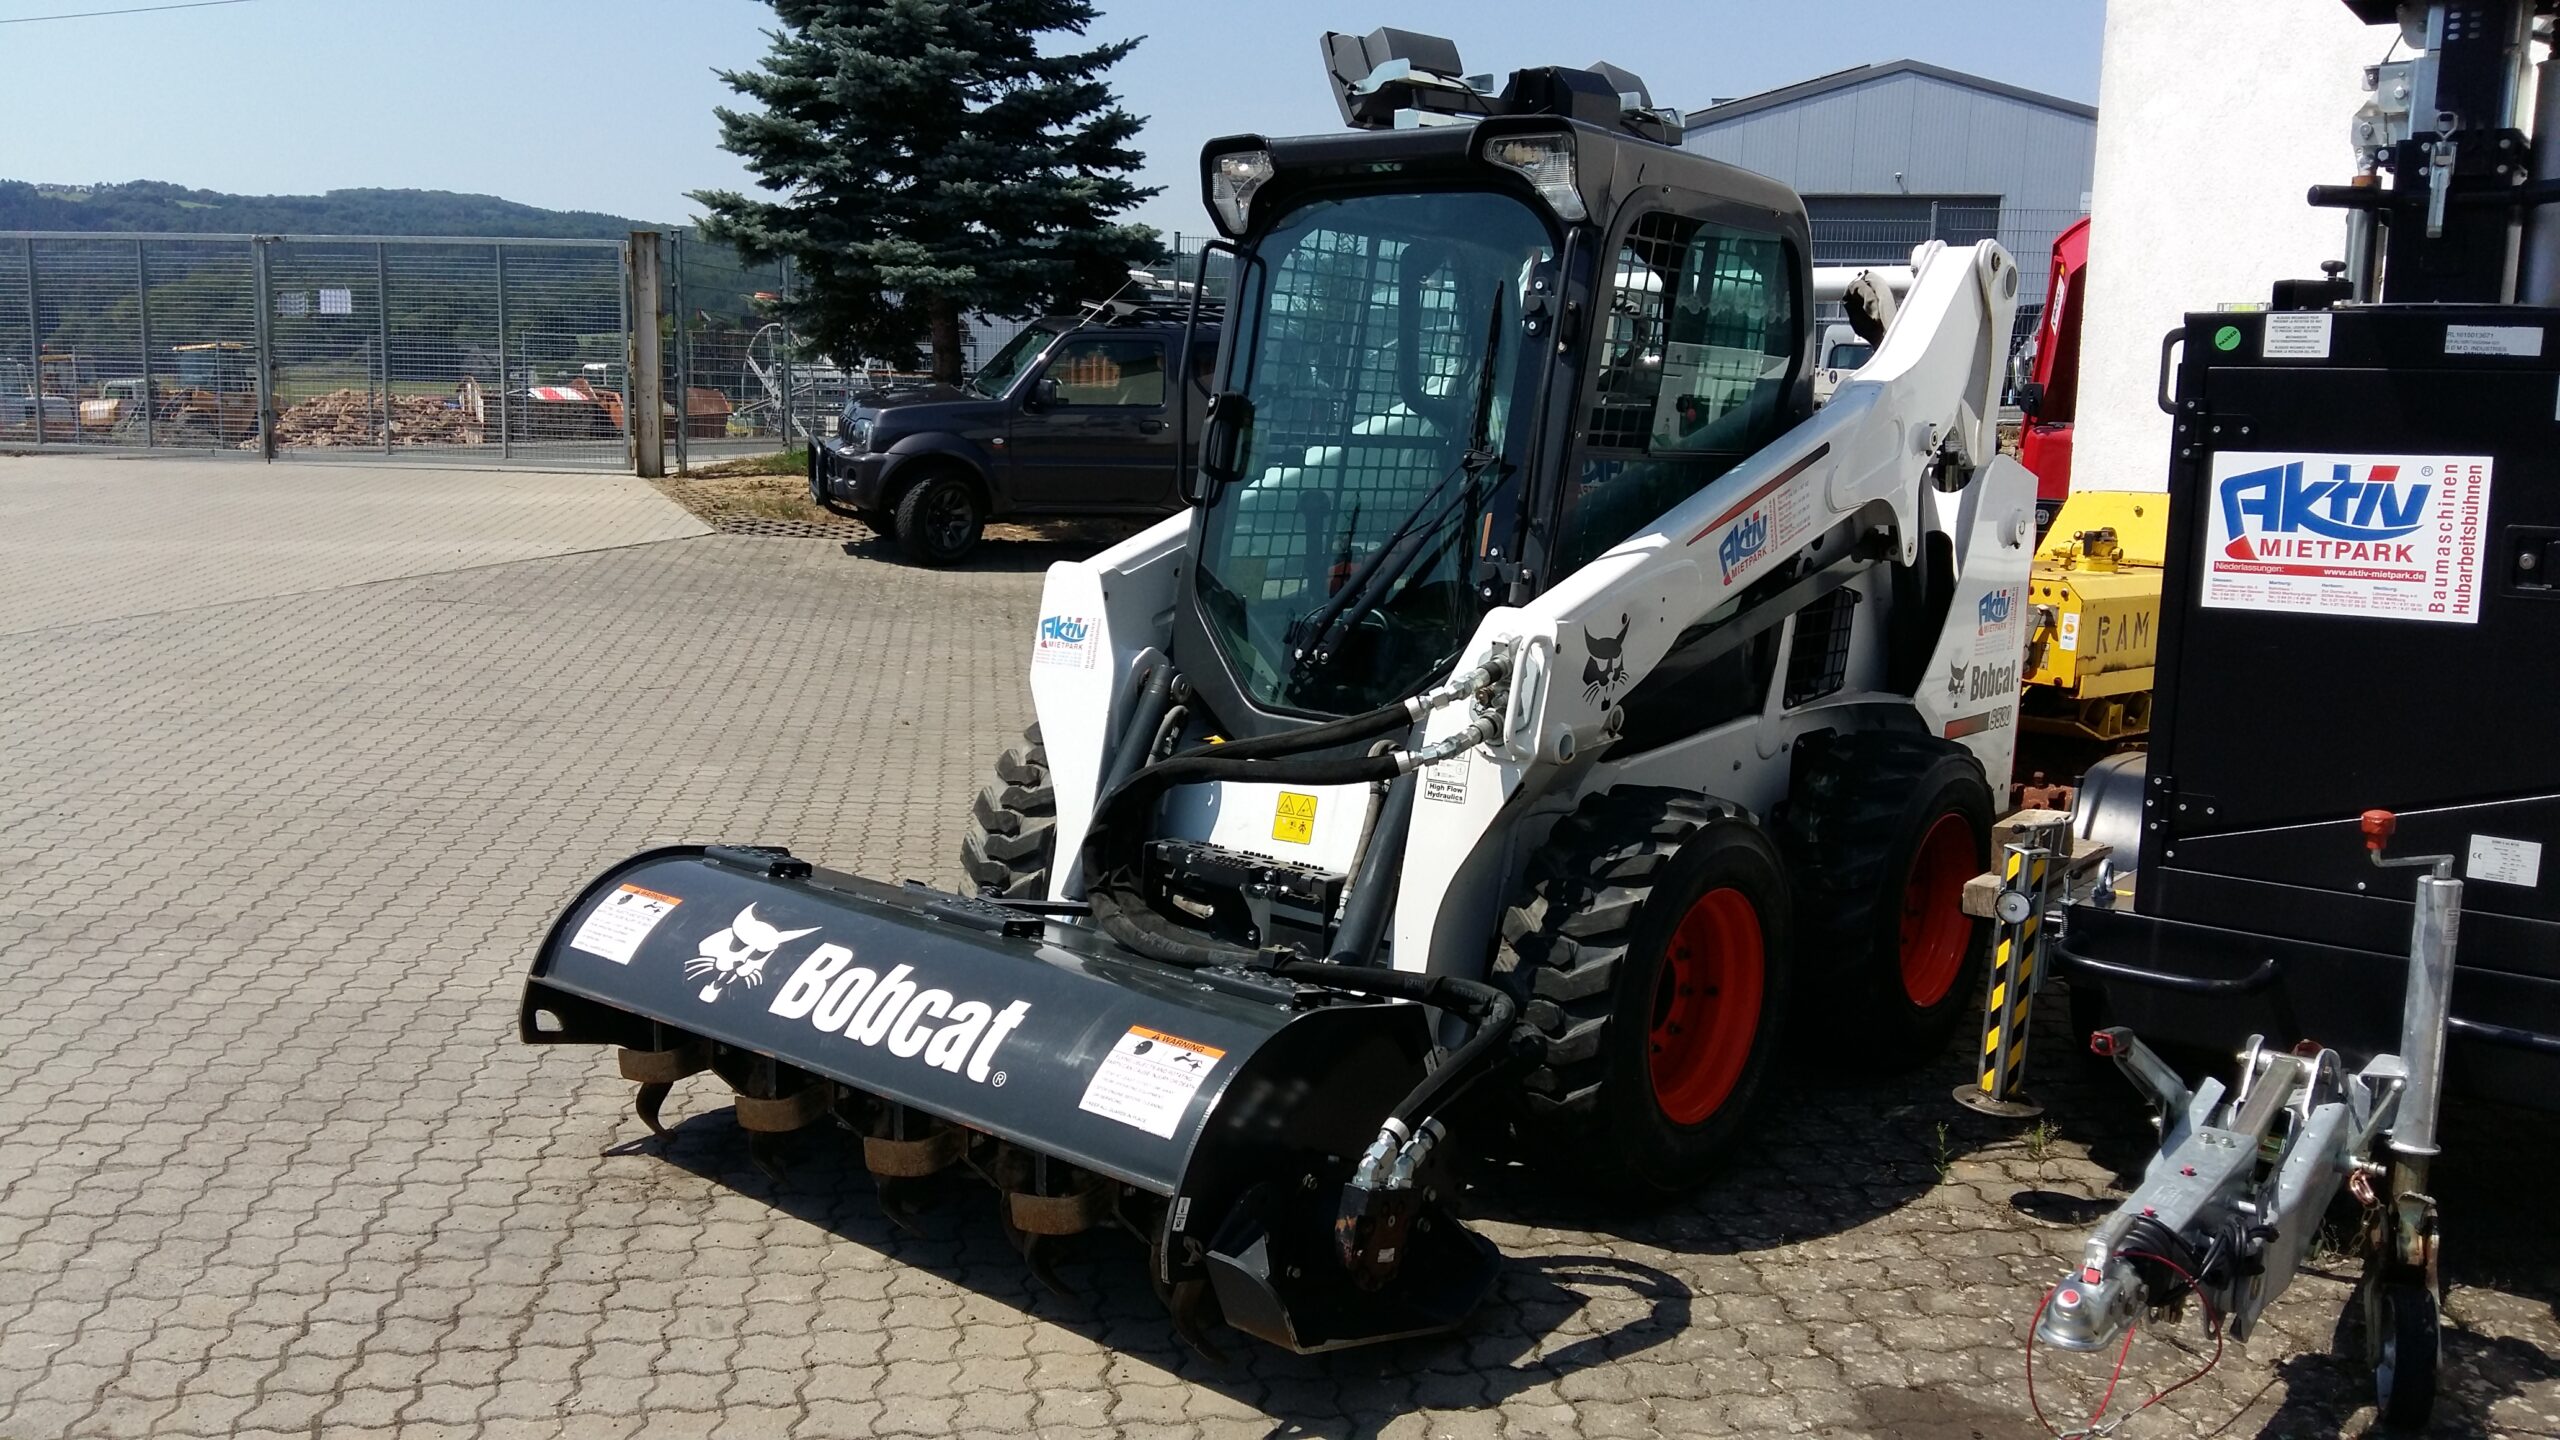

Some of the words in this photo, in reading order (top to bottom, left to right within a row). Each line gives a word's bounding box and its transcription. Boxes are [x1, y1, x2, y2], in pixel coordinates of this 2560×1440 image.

[2428, 463, 2459, 613] Baumaschinen
[2452, 464, 2483, 615] Hubarbeitsbühnen
[2259, 537, 2414, 563] MIETPARK
[1731, 546, 1768, 579] MIETPARK
[2215, 562, 2285, 574] Niederlassungen:
[2323, 569, 2424, 580] www.aktiv-mietpark.de
[1048, 641, 1083, 651] MIETPARK
[1969, 658, 2017, 702] Bobcat
[1427, 790, 1463, 801] Hydraulics
[1429, 782, 1445, 791] High
[1446, 785, 1463, 794] Flow
[768, 941, 1031, 1084] Bobcat
[1161, 1034, 1205, 1053] WARNING
